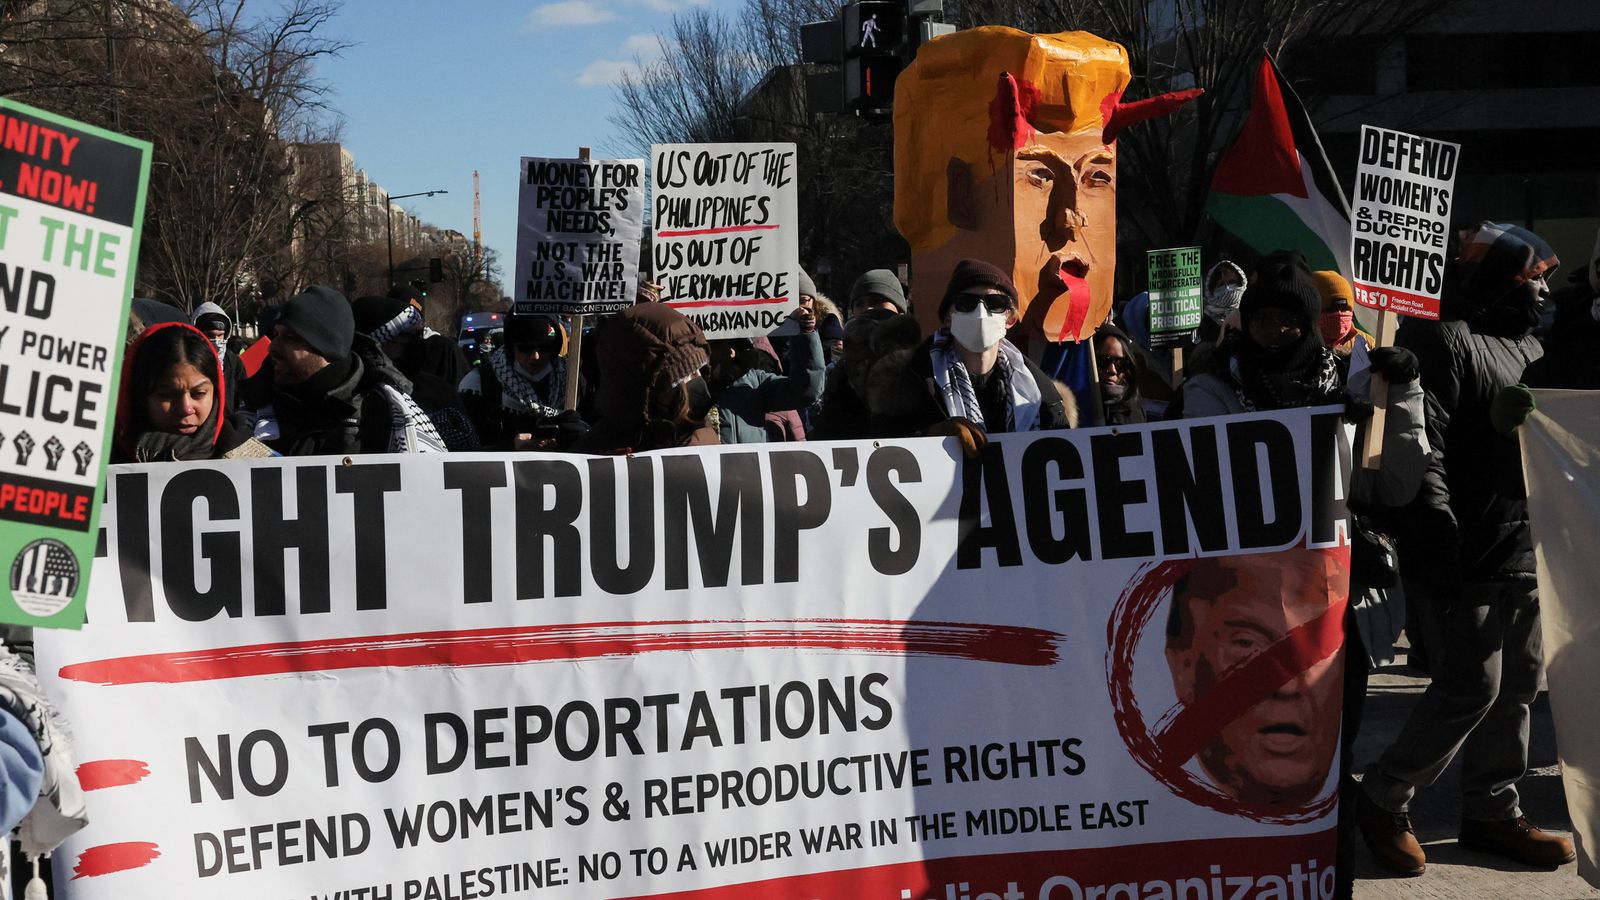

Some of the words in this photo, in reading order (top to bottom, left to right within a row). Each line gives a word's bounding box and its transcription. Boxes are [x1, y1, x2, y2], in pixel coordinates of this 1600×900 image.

[656, 151, 691, 189] US
[693, 151, 733, 187] OUT
[733, 151, 760, 185] OF
[761, 149, 794, 189] THE
[1362, 127, 1457, 182] DEFEND
[17, 162, 97, 214] NOW!
[527, 162, 599, 187] MONEY
[602, 164, 639, 188] FOR
[536, 187, 629, 211] PEOPLE'S
[1360, 172, 1450, 217] WOMEN'S
[546, 210, 616, 237] NEEDS,
[655, 195, 771, 230] PHILIPPINES
[1356, 206, 1373, 220] &
[1378, 209, 1445, 234] REPRO
[40, 216, 121, 278] THE
[1356, 219, 1444, 248] DUCTIVE
[536, 242, 579, 261] NOT
[585, 243, 624, 263] THE
[655, 242, 684, 272] US
[687, 237, 728, 267] OUT
[730, 236, 763, 267] OF
[1149, 254, 1177, 269] FREE
[1181, 252, 1199, 266] THE
[1354, 237, 1444, 295] RIGHTS
[531, 261, 573, 281] U.S.
[582, 263, 625, 282] WAR
[1149, 277, 1200, 290] INCARCERATED
[1151, 267, 1198, 280] WRONGFULLY
[526, 281, 627, 301] MACHINE!
[656, 272, 789, 303] EVERYWHERE
[1391, 296, 1411, 306] Freedom
[1411, 300, 1424, 308] Road
[518, 304, 533, 312] WE
[534, 304, 560, 312] FIGHT
[563, 305, 587, 313] BACK
[588, 303, 632, 312] NETWORK
[1151, 298, 1200, 315] POLITICAL
[1151, 313, 1201, 329] PRISONERS
[1409, 306, 1439, 318] Organization
[20, 330, 108, 372] POWER
[0, 483, 89, 522] PEOPLE
[84, 463, 401, 624] IGHT
[443, 445, 922, 604] TRUMP'S
[956, 413, 1351, 570] AGENDA
[184, 729, 288, 804] NO
[307, 717, 402, 788] TO
[424, 672, 893, 776] DEPORTATIONS
[193, 812, 371, 878] DEFEND
[383, 785, 590, 850] WOMEN'S
[602, 781, 631, 822] &
[644, 748, 932, 819] REPRODUCTIVE
[943, 737, 1086, 784] RIGHTS
[404, 857, 568, 900] PALESTINE:
[578, 851, 621, 883] NO
[629, 846, 668, 877] TO
[676, 843, 698, 873] A
[704, 831, 793, 868] WIDER
[799, 822, 862, 855] WAR
[870, 818, 898, 849] IN
[905, 811, 958, 843] THE
[965, 804, 1071, 836] MIDDLE
[1080, 799, 1149, 831] EAST
